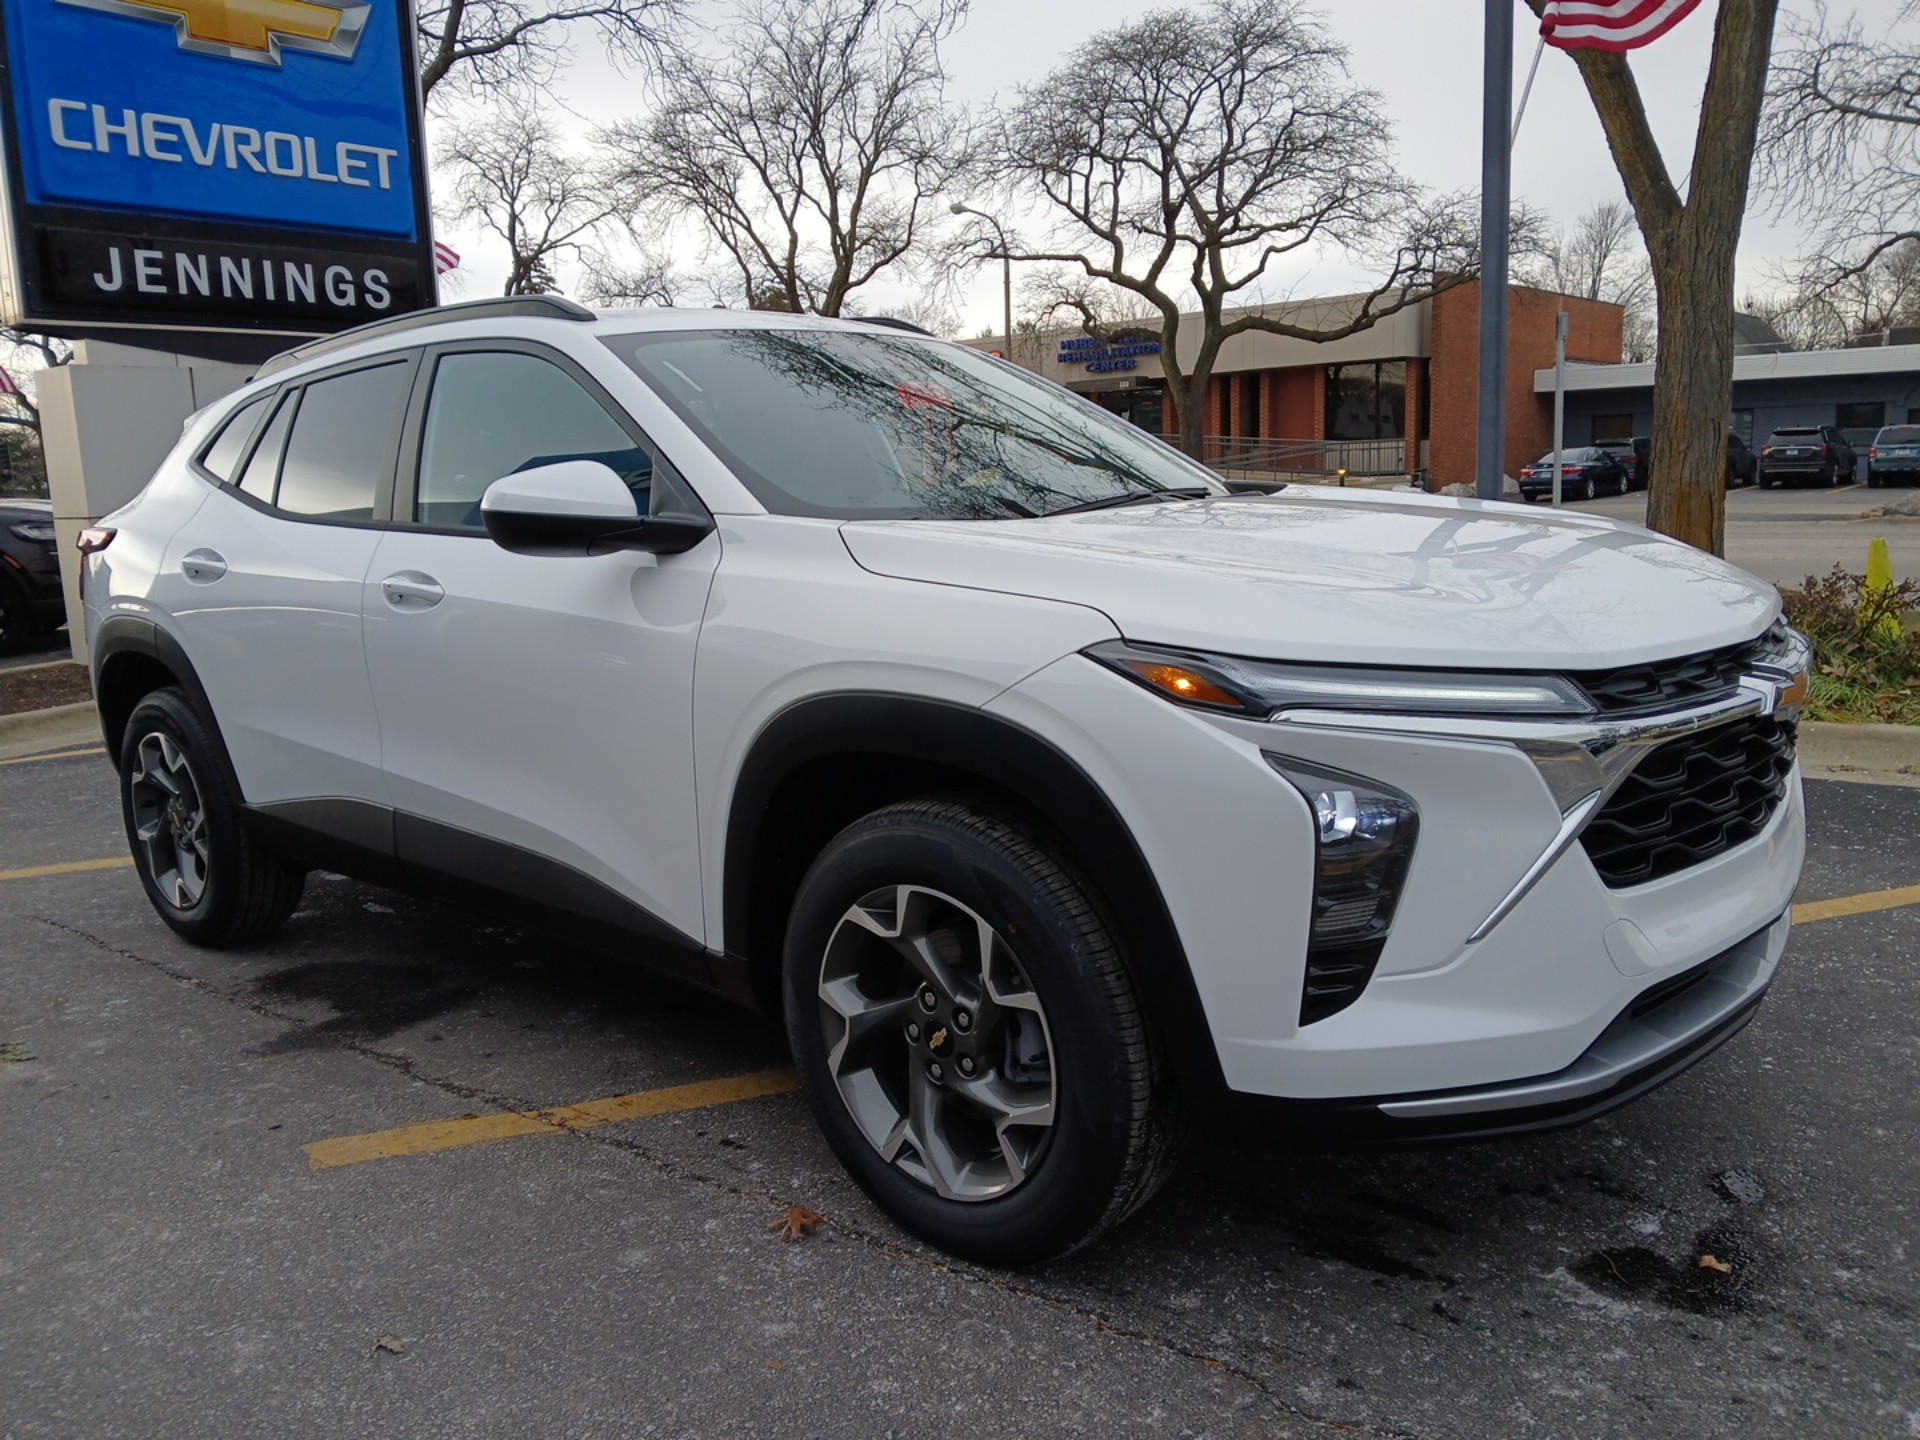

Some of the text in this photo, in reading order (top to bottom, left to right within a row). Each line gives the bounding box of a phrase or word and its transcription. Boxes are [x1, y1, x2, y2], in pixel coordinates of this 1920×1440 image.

[48, 98, 398, 190] CHEVROLET
[93, 247, 392, 310] JENNINGS
[1086, 359, 1136, 373] CENTER
